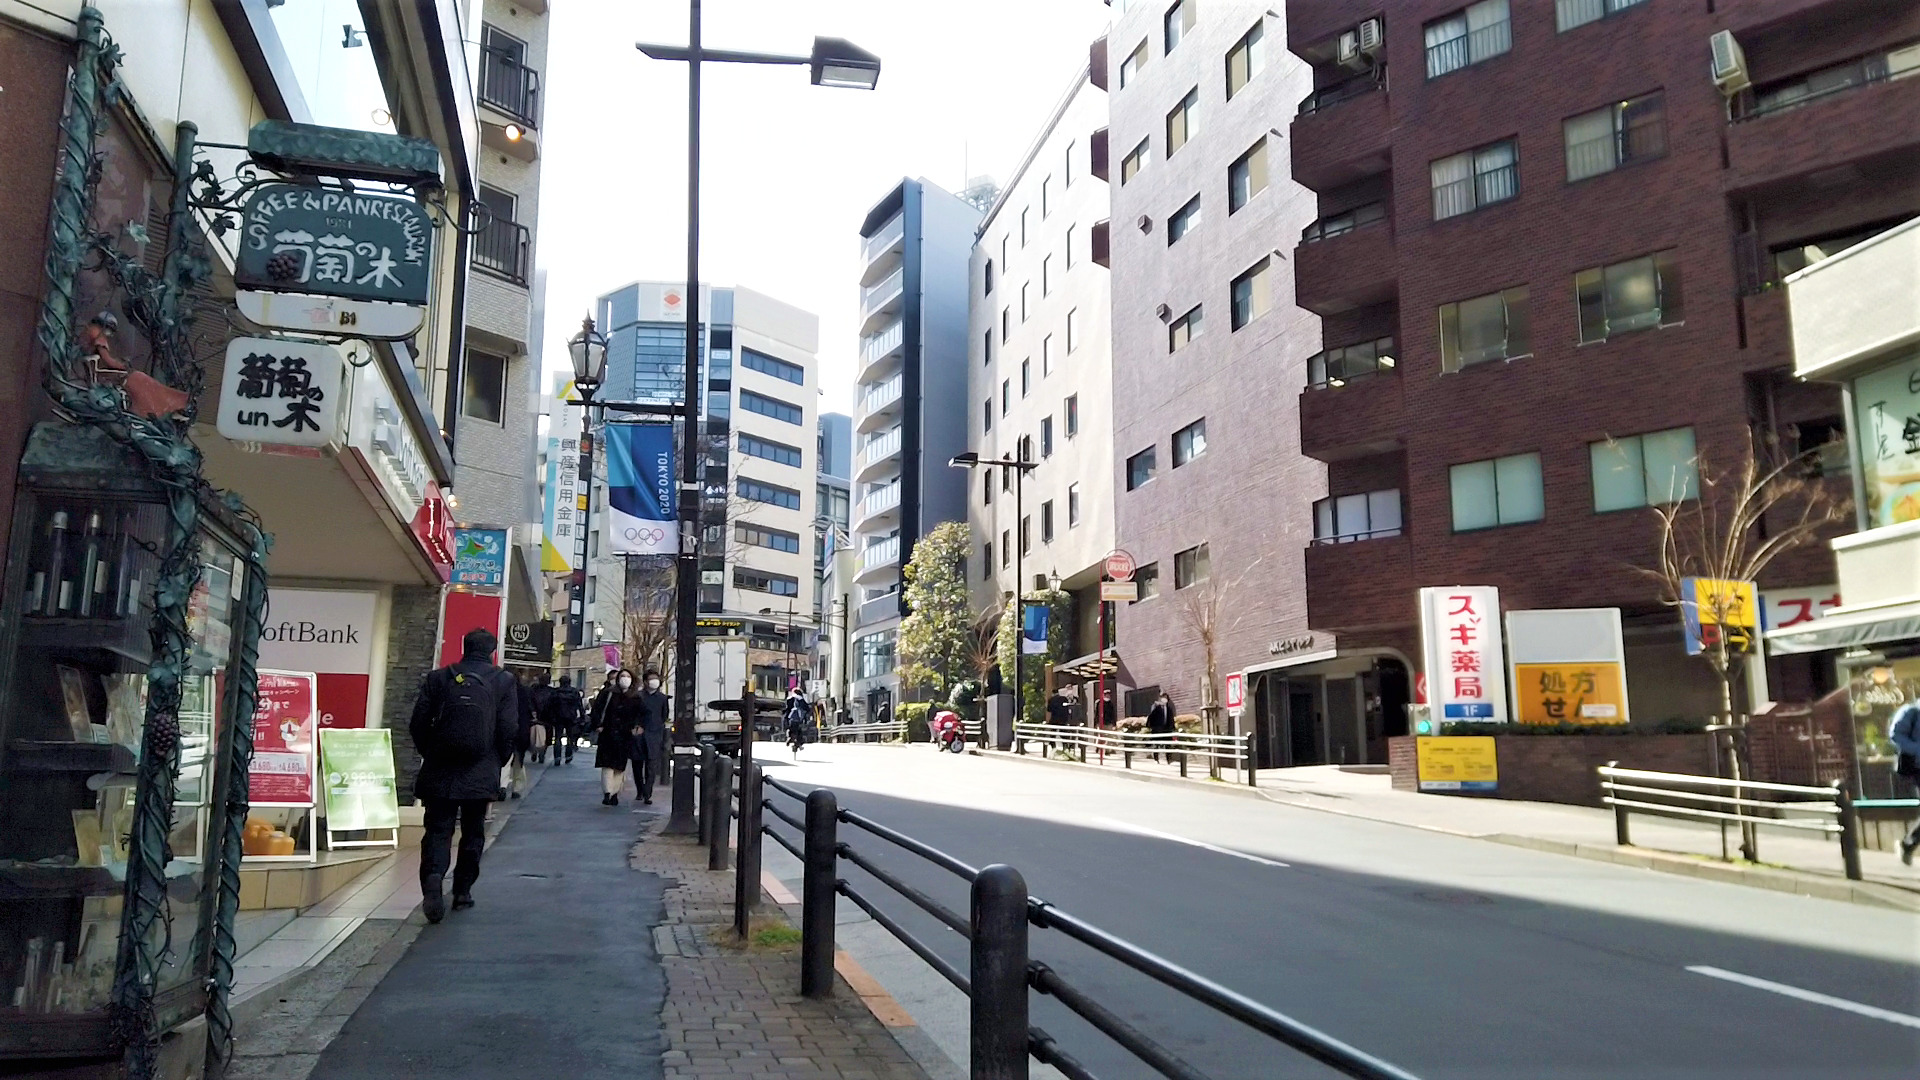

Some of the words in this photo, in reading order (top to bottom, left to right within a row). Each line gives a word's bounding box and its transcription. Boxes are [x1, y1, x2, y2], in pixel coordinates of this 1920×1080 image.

[339, 310, 357, 326] B1
[237, 410, 269, 427] un
[657, 452, 669, 487] TOKYO
[658, 488, 671, 515] 2020
[261, 621, 359, 644] oftBank
[1448, 594, 1483, 699] スギ薬局
[1539, 671, 1597, 694] 処方
[1463, 704, 1478, 716] 1F
